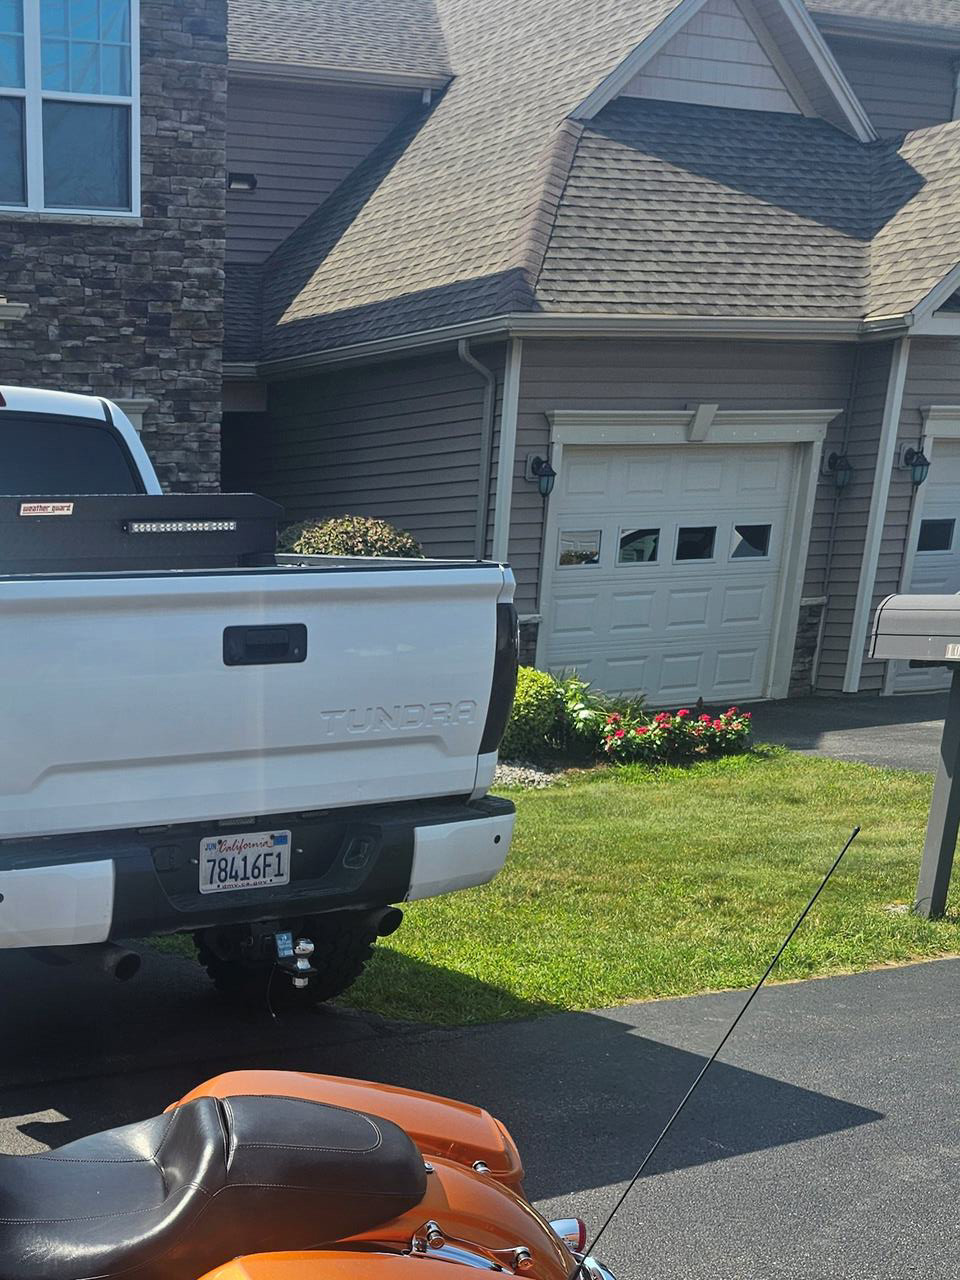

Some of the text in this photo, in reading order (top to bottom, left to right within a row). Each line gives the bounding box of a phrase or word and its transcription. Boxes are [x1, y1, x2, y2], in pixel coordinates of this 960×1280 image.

[320, 700, 478, 736] TUNDRA
[219, 839, 273, 854] California
[207, 852, 284, 885] 78416F1
